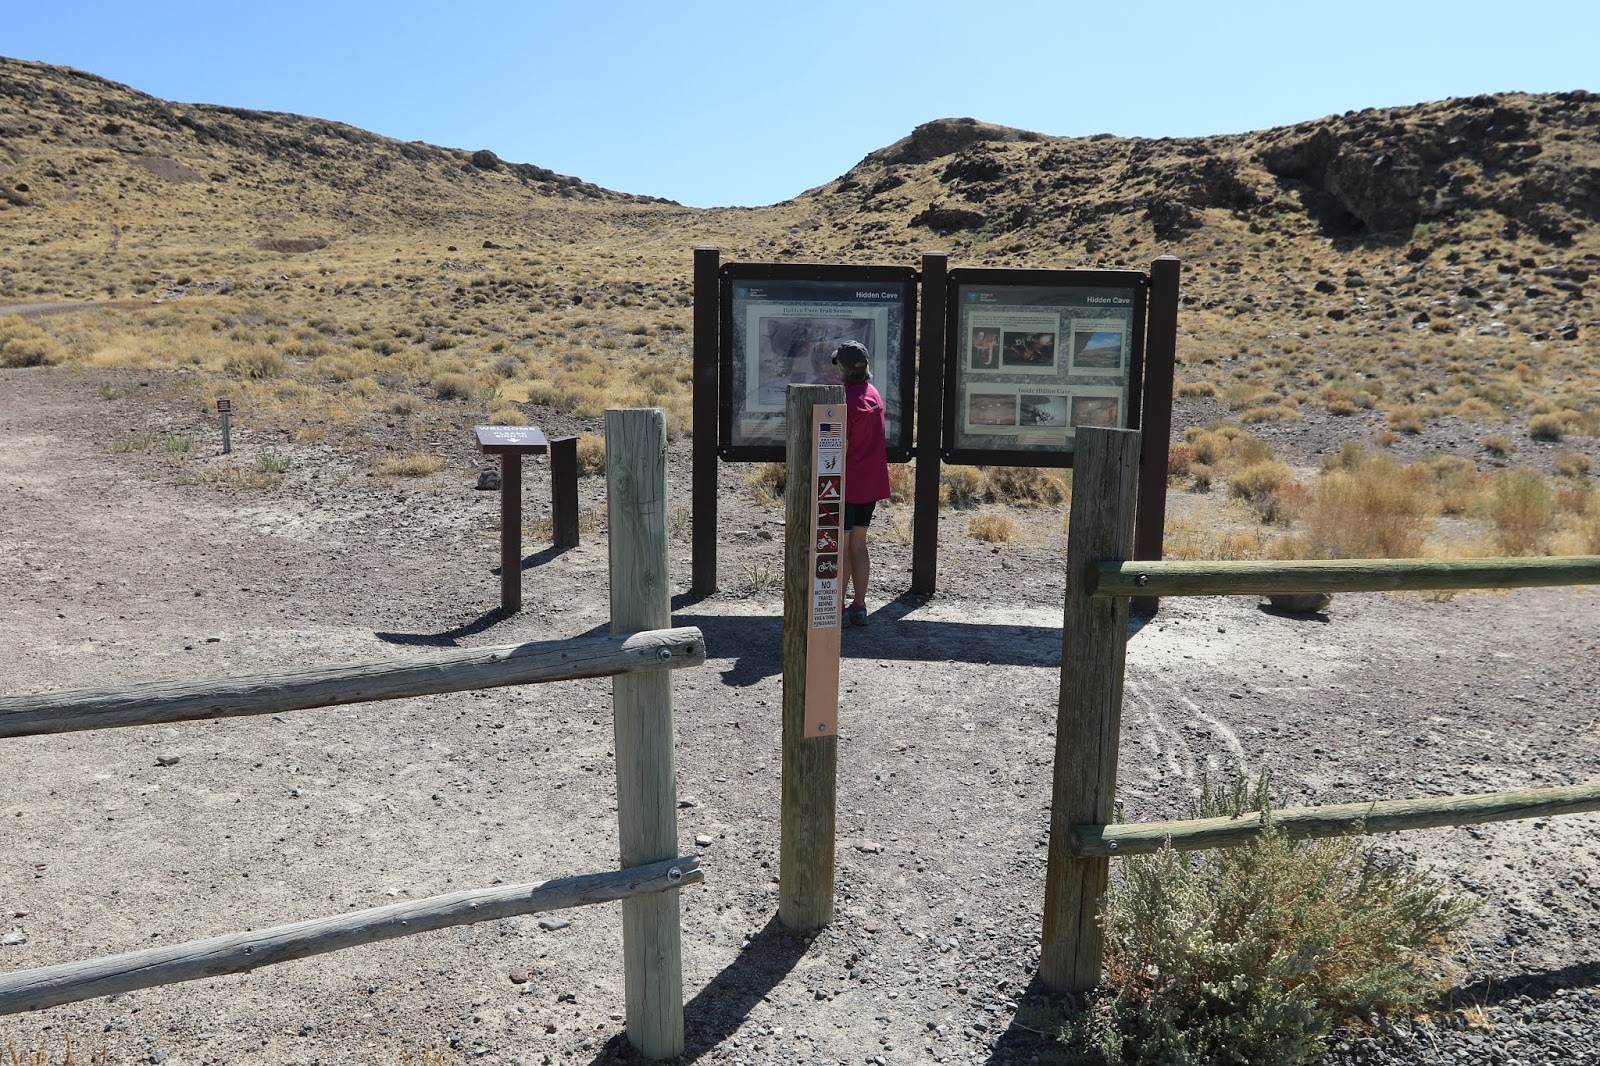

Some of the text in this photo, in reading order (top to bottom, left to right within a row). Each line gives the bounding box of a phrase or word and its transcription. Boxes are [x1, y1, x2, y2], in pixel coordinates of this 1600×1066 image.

[855, 291, 898, 299] Hidden Cave
[1086, 296, 1131, 304] Hidden Cave
[821, 581, 831, 589] NO
